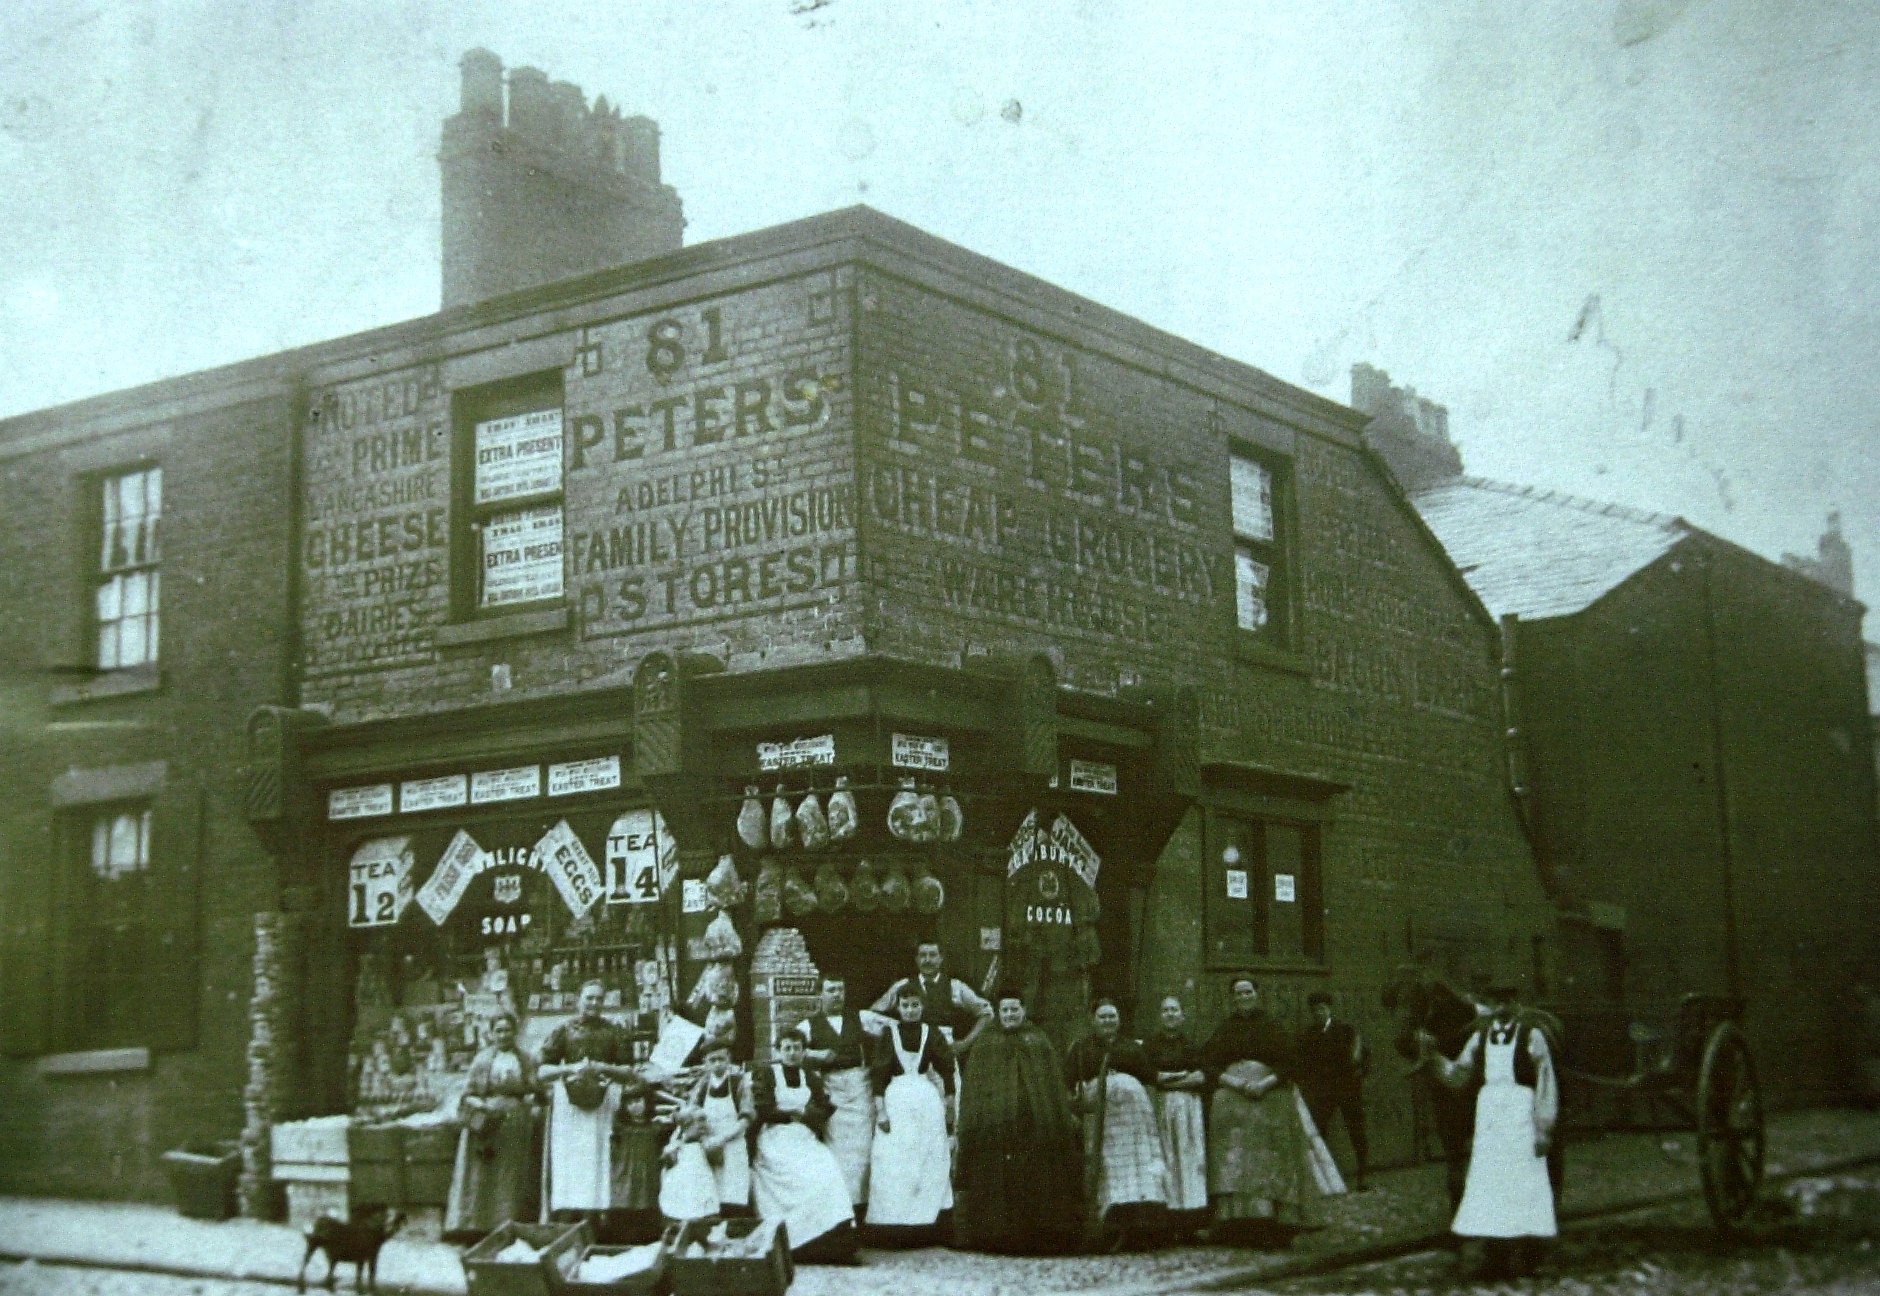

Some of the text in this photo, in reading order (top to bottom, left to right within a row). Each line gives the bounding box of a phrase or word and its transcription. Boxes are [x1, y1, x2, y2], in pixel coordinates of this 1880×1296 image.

[647, 308, 728, 375] 81
[570, 366, 827, 471] PETERS
[352, 421, 442, 478] PRIME
[480, 435, 561, 465] EXTRA PRESENT
[615, 465, 736, 514] ADELPHI
[306, 507, 447, 568] CHEESE
[571, 510, 692, 576] FAMILY
[486, 548, 520, 567] EXTRA
[618, 548, 818, 621] STORES
[589, 774, 618, 787] TREAT
[608, 834, 657, 852] TEA
[351, 862, 396, 879] TEA
[481, 914, 532, 935] SOAP
[1027, 905, 1072, 925] COCOA
